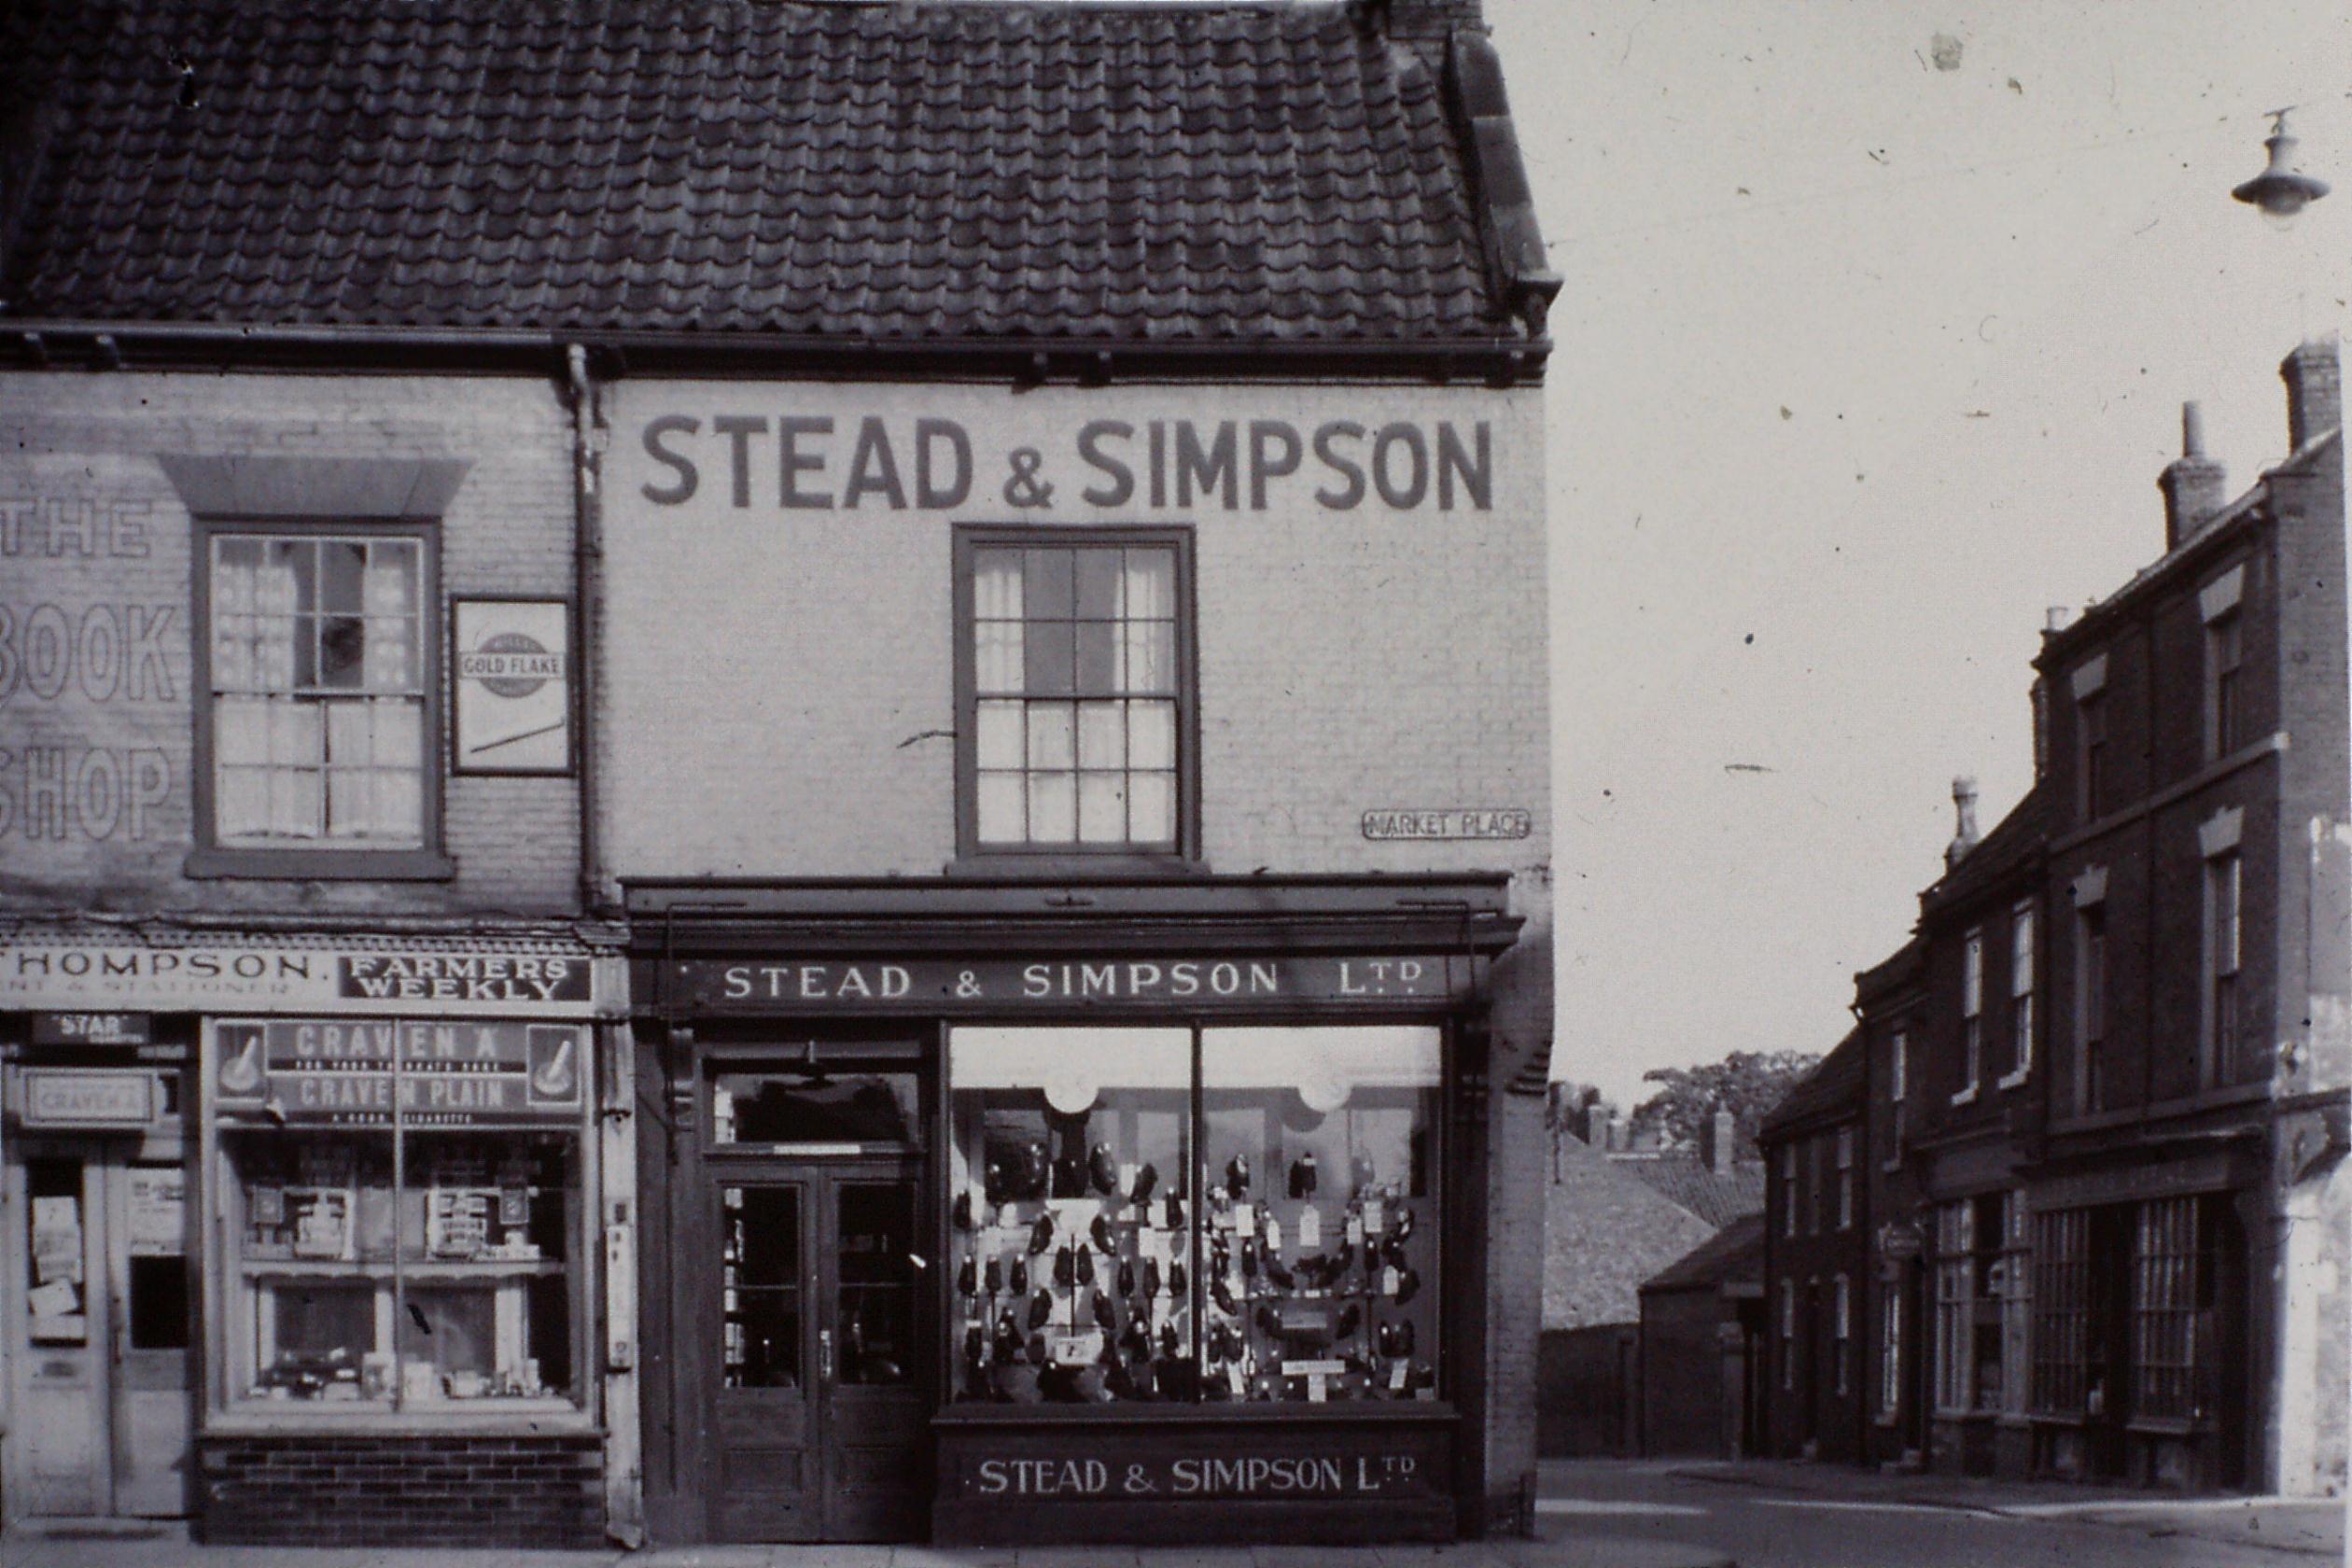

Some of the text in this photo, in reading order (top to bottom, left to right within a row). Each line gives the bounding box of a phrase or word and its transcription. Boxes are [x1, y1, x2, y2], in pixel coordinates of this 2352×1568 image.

[640, 413, 1493, 511] STEAD & SIMPSON
[0, 497, 152, 558] THE
[464, 656, 558, 674] GOLD FLAKE
[1367, 814, 1526, 834] MARKET PLACE
[350, 956, 568, 979] FARMERS
[724, 966, 911, 998] STEAD
[956, 970, 982, 998] &
[1023, 962, 1277, 997] SIMPSON
[357, 978, 560, 1001] WEEKLY
[295, 1026, 455, 1057] CRAVEN
[300, 1078, 504, 1107] CRAVEN PLAIN
[979, 1460, 1108, 1493] STEAD
[1124, 1463, 1159, 1491] &
[1171, 1457, 1342, 1492] SIMPSON
